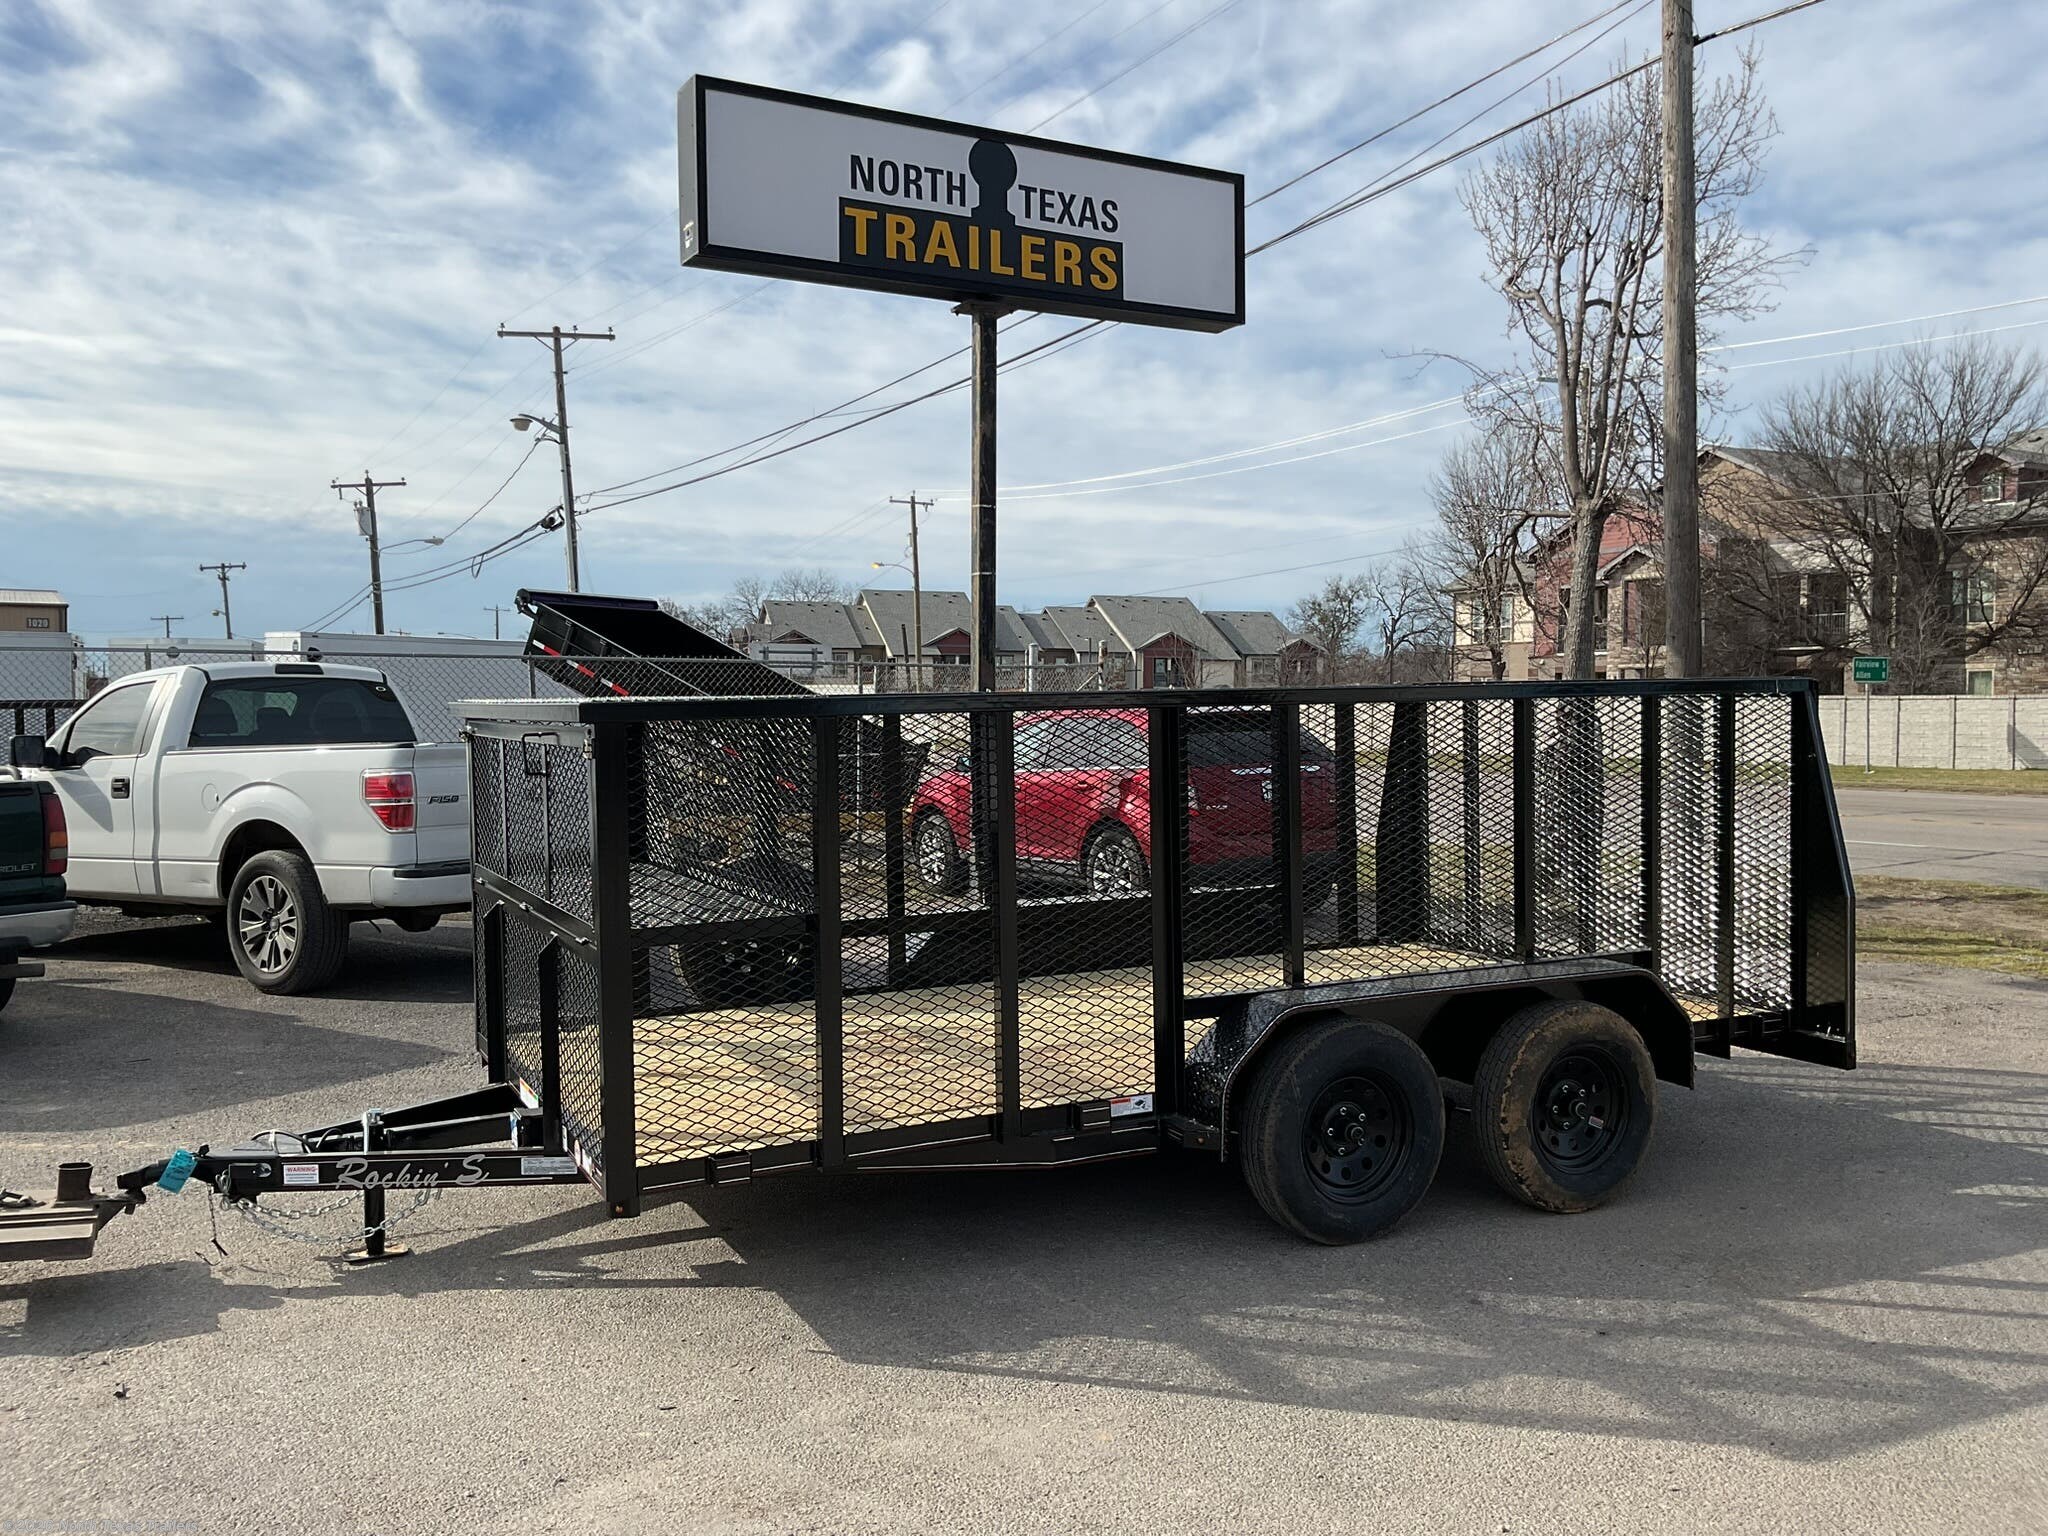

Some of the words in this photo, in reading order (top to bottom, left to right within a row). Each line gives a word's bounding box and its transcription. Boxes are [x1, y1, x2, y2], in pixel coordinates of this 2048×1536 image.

[850, 154, 966, 207] NORTH
[1018, 184, 1118, 233] TEXAS
[844, 206, 1118, 290] TRAILERS
[456, 1153, 490, 1186] S
